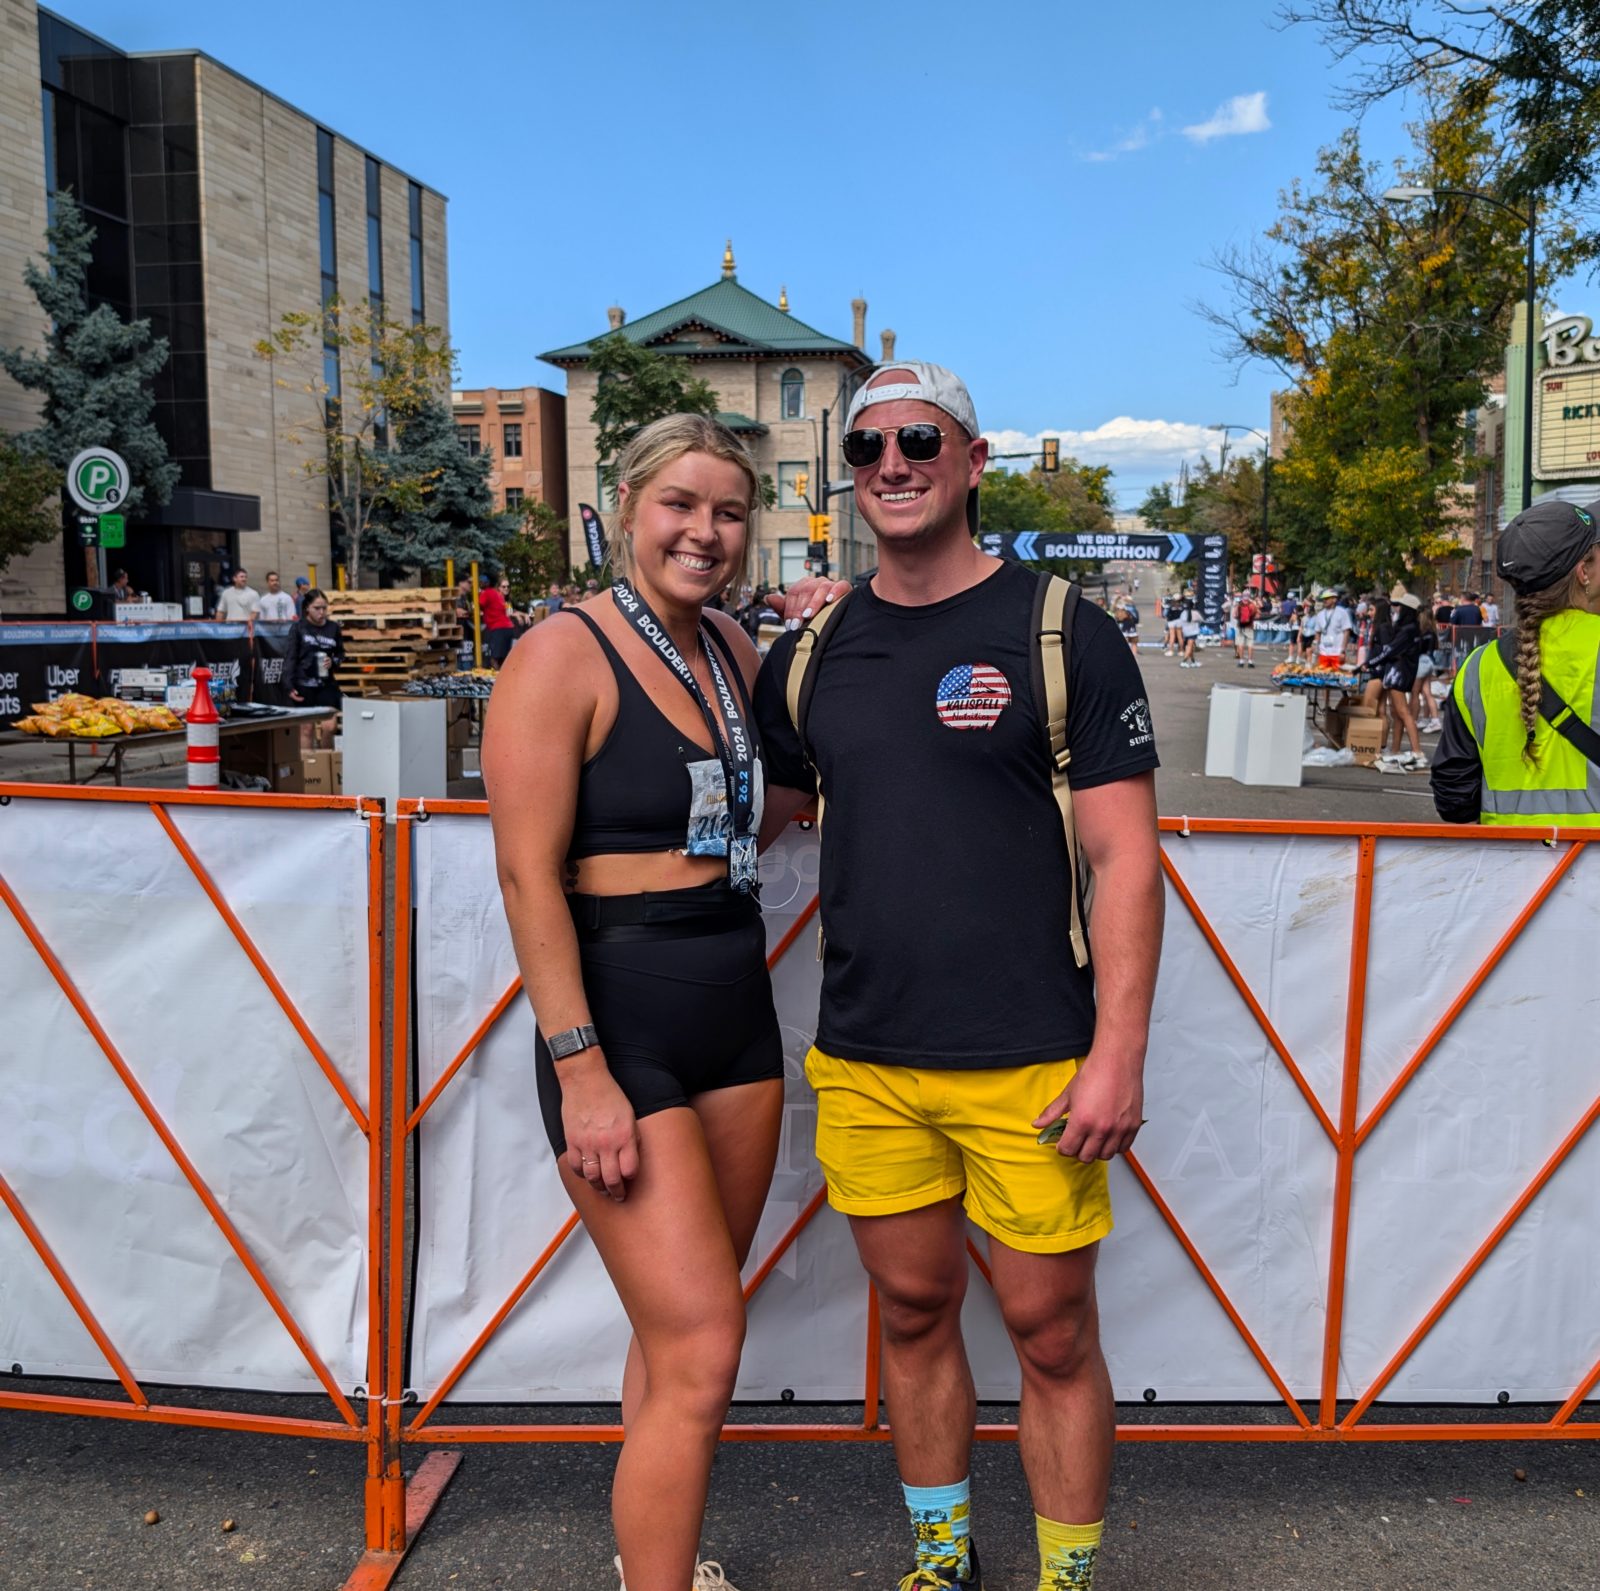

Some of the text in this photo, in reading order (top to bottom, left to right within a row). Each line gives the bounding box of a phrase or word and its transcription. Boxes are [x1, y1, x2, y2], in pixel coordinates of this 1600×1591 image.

[88, 466, 110, 495] P
[588, 520, 603, 566] MEDICAL
[1076, 534, 1129, 545] WE DID IT
[1045, 544, 1160, 559] BOULDERTHON
[613, 584, 639, 612] 2024
[262, 658, 284, 671] FLEET
[47, 665, 80, 686] Uber
[264, 671, 282, 684] FEET
[946, 699, 999, 711] KALISPELL
[953, 711, 992, 721] Nutrition
[737, 726, 749, 762] 2024
[1350, 743, 1376, 754] bare
[738, 771, 748, 803] 26.2
